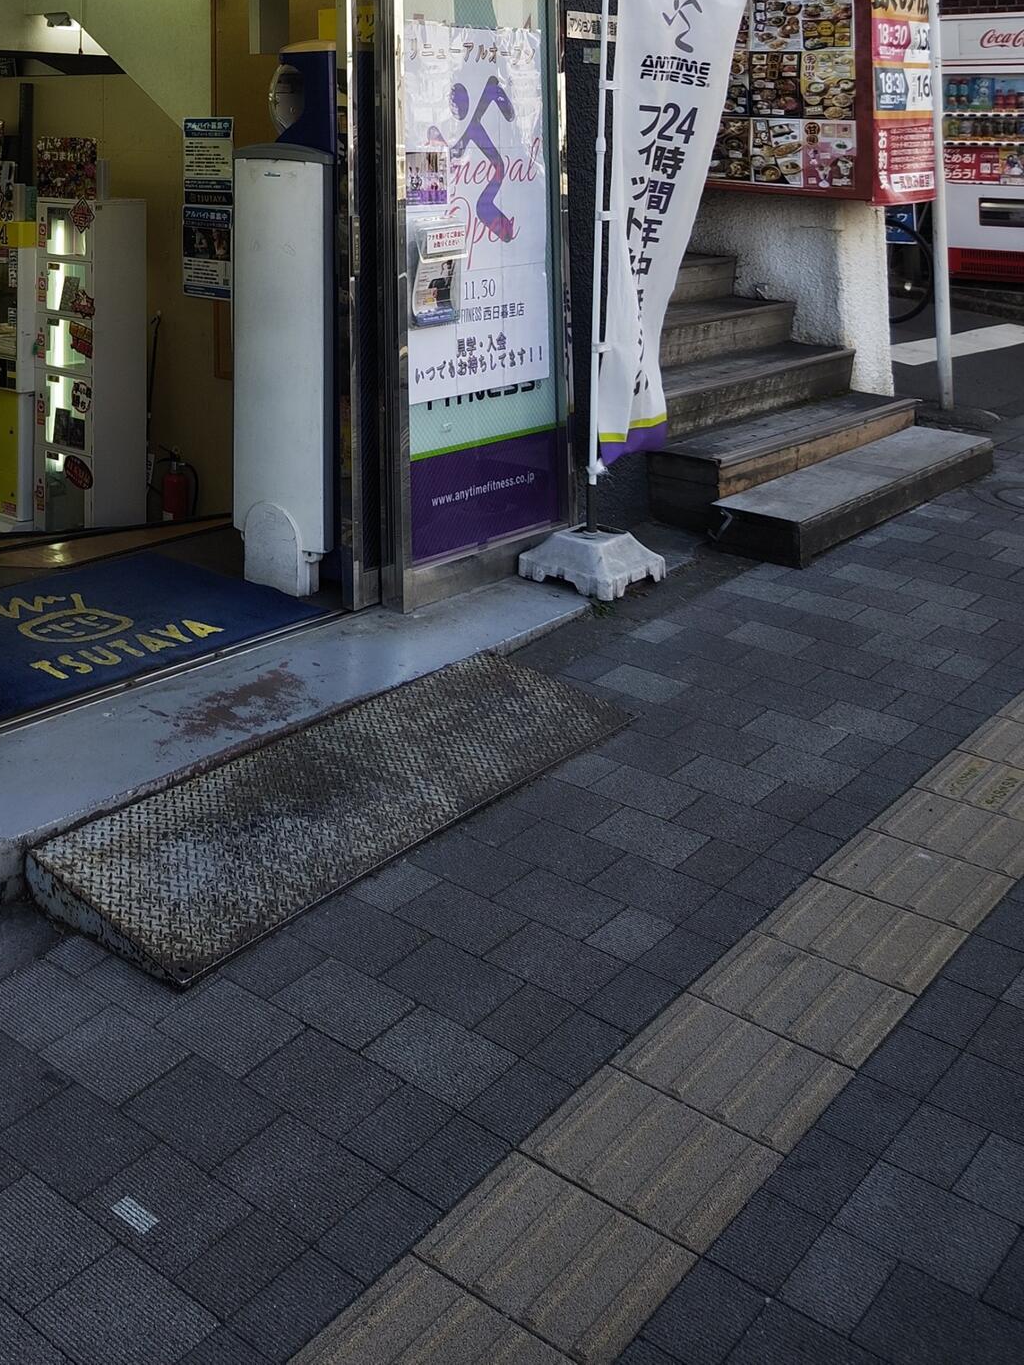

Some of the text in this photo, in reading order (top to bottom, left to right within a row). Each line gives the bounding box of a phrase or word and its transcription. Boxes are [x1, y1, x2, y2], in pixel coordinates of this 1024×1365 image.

[878, 23, 908, 46] 18:30
[464, 278, 496, 301] 11.30
[483, 302, 525, 321] 西日暮里店
[456, 332, 508, 359] 見学・入会
[414, 345, 544, 385] いつでもお持ちしてます！！
[431, 471, 536, 507] www.anytimefitness.co.jp
[29, 619, 225, 680] TSUTAYA
